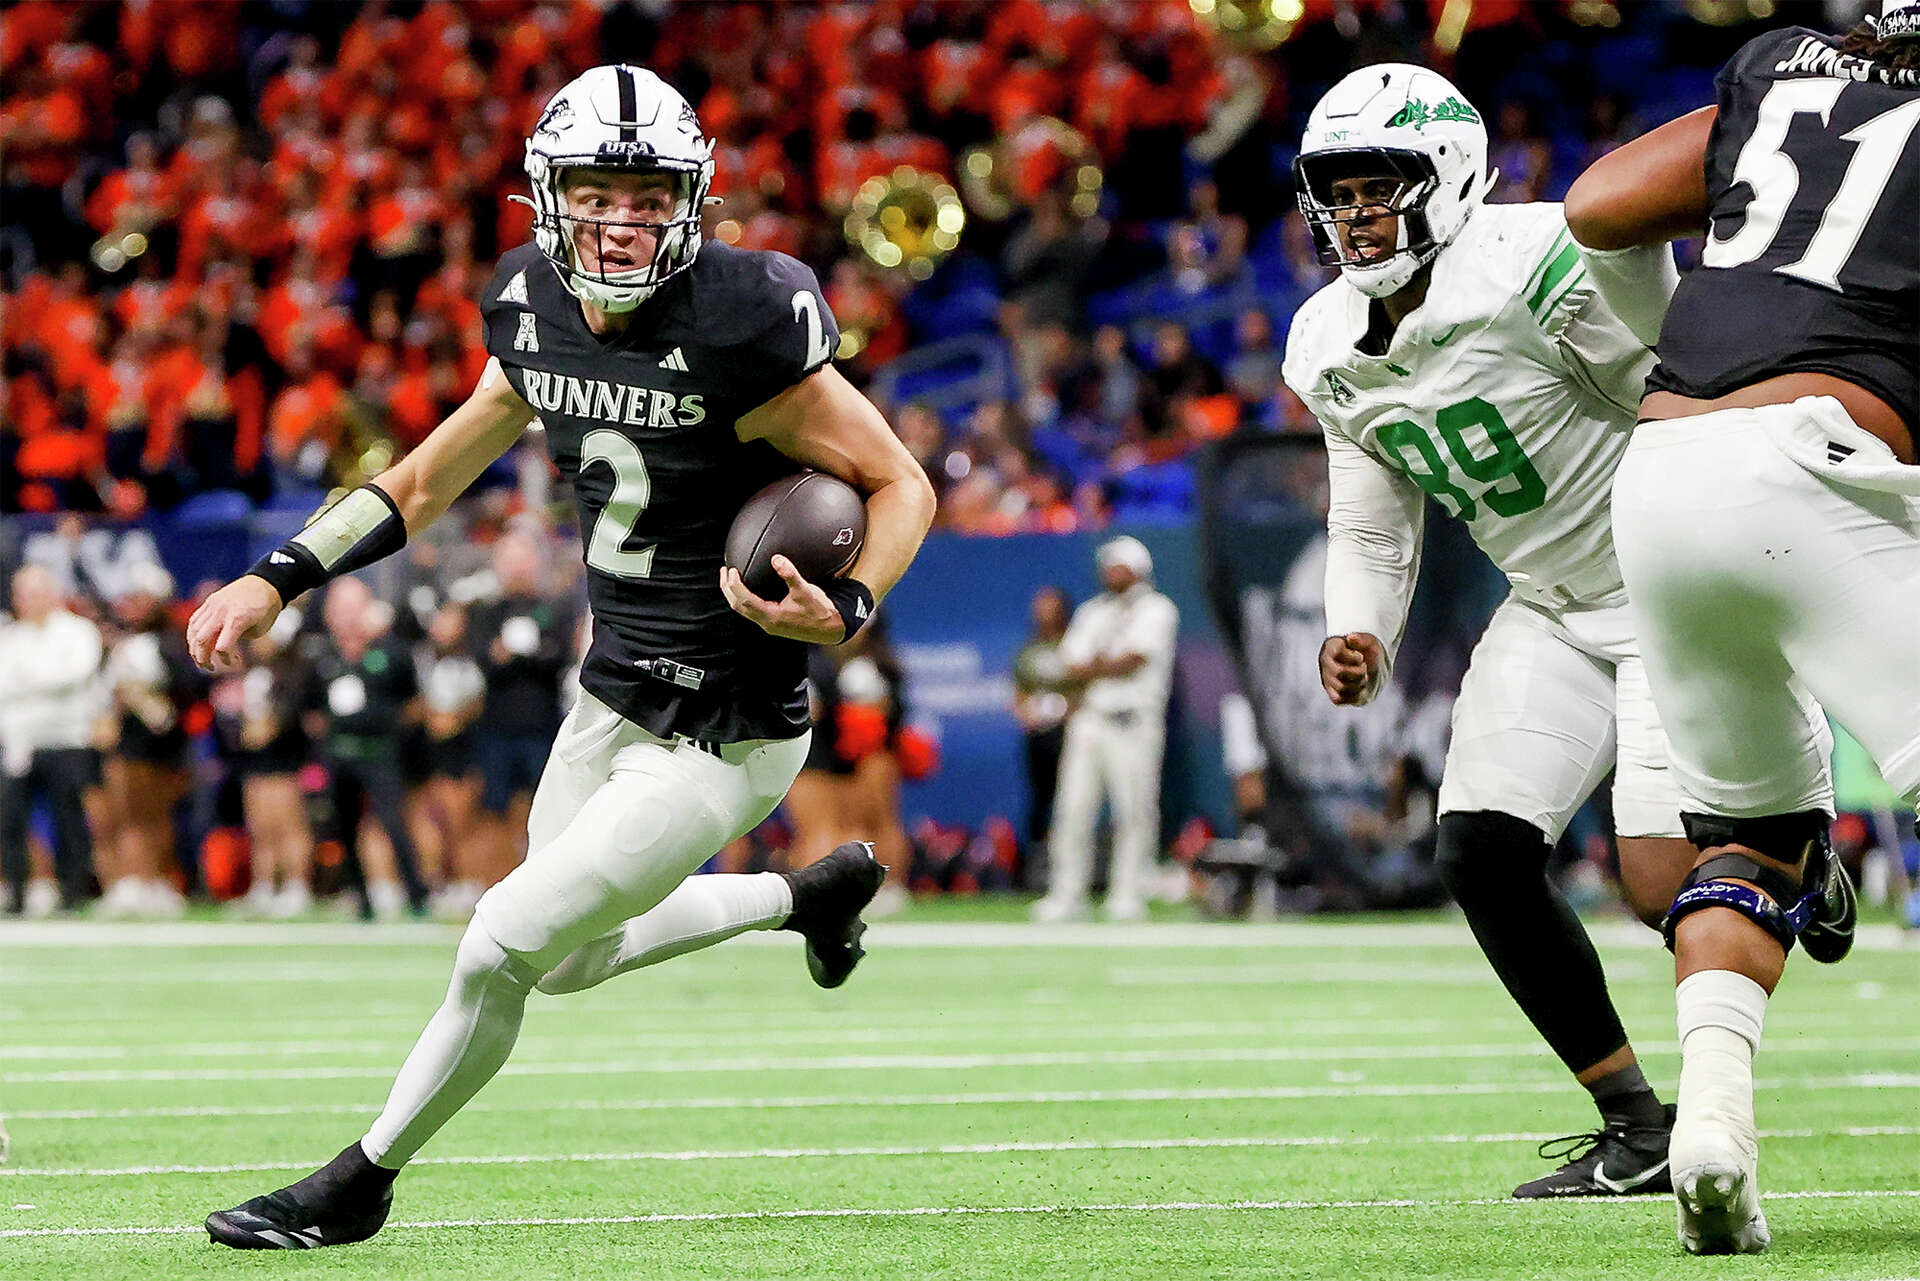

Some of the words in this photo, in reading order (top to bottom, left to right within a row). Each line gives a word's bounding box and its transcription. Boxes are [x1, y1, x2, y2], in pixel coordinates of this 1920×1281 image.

[1774, 36, 1875, 82] JAMES
[606, 140, 650, 154] UTSA
[1324, 130, 1350, 143] UNT
[1702, 77, 1920, 293] 51
[513, 312, 540, 353] A
[791, 290, 832, 373] 2
[522, 367, 706, 428] RUNNERS
[1375, 395, 1547, 522] 89
[579, 428, 656, 579] 2
